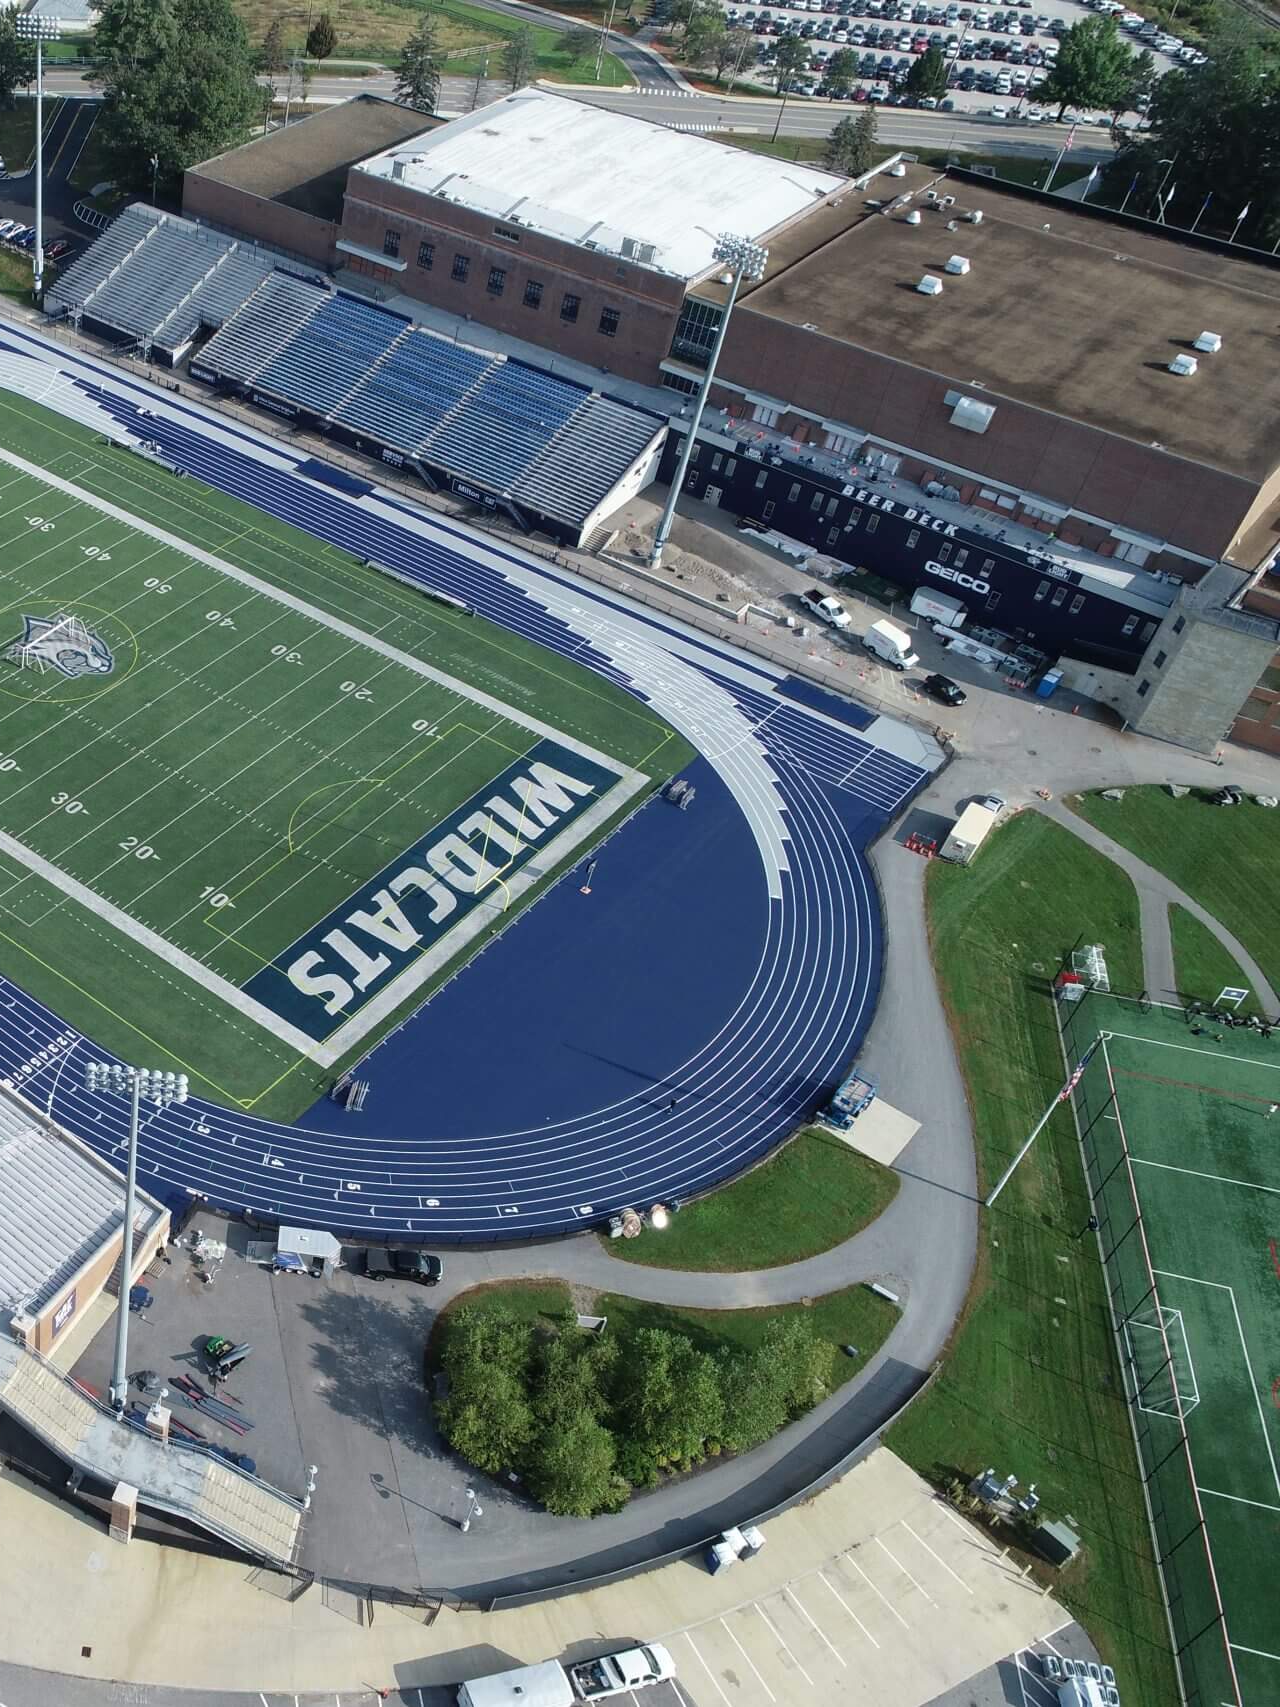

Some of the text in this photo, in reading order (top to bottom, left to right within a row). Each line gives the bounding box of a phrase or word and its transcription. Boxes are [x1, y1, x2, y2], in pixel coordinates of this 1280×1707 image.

[842, 484, 960, 537] BEER DECK
[28, 516, 56, 532] 30
[84, 546, 112, 561] 40
[924, 560, 990, 594] GEICO
[143, 577, 173, 594] 50
[205, 610, 236, 628] 40
[270, 644, 302, 663] 30
[339, 681, 373, 700] 20
[411, 719, 439, 737] 10
[51, 792, 84, 814] 30
[118, 836, 154, 860] 20
[286, 760, 596, 1017] WILDCATS
[199, 886, 229, 908] 10
[56, 1036, 68, 1046] 2
[65, 1030, 77, 1039] 1
[38, 1051, 49, 1060] 4
[47, 1043, 59, 1053] 3
[30, 1057, 42, 1067] 5
[13, 1071, 24, 1081] 7
[197, 1124, 211, 1134] 3
[271, 1158, 285, 1168] 4
[347, 1182, 361, 1191] 5
